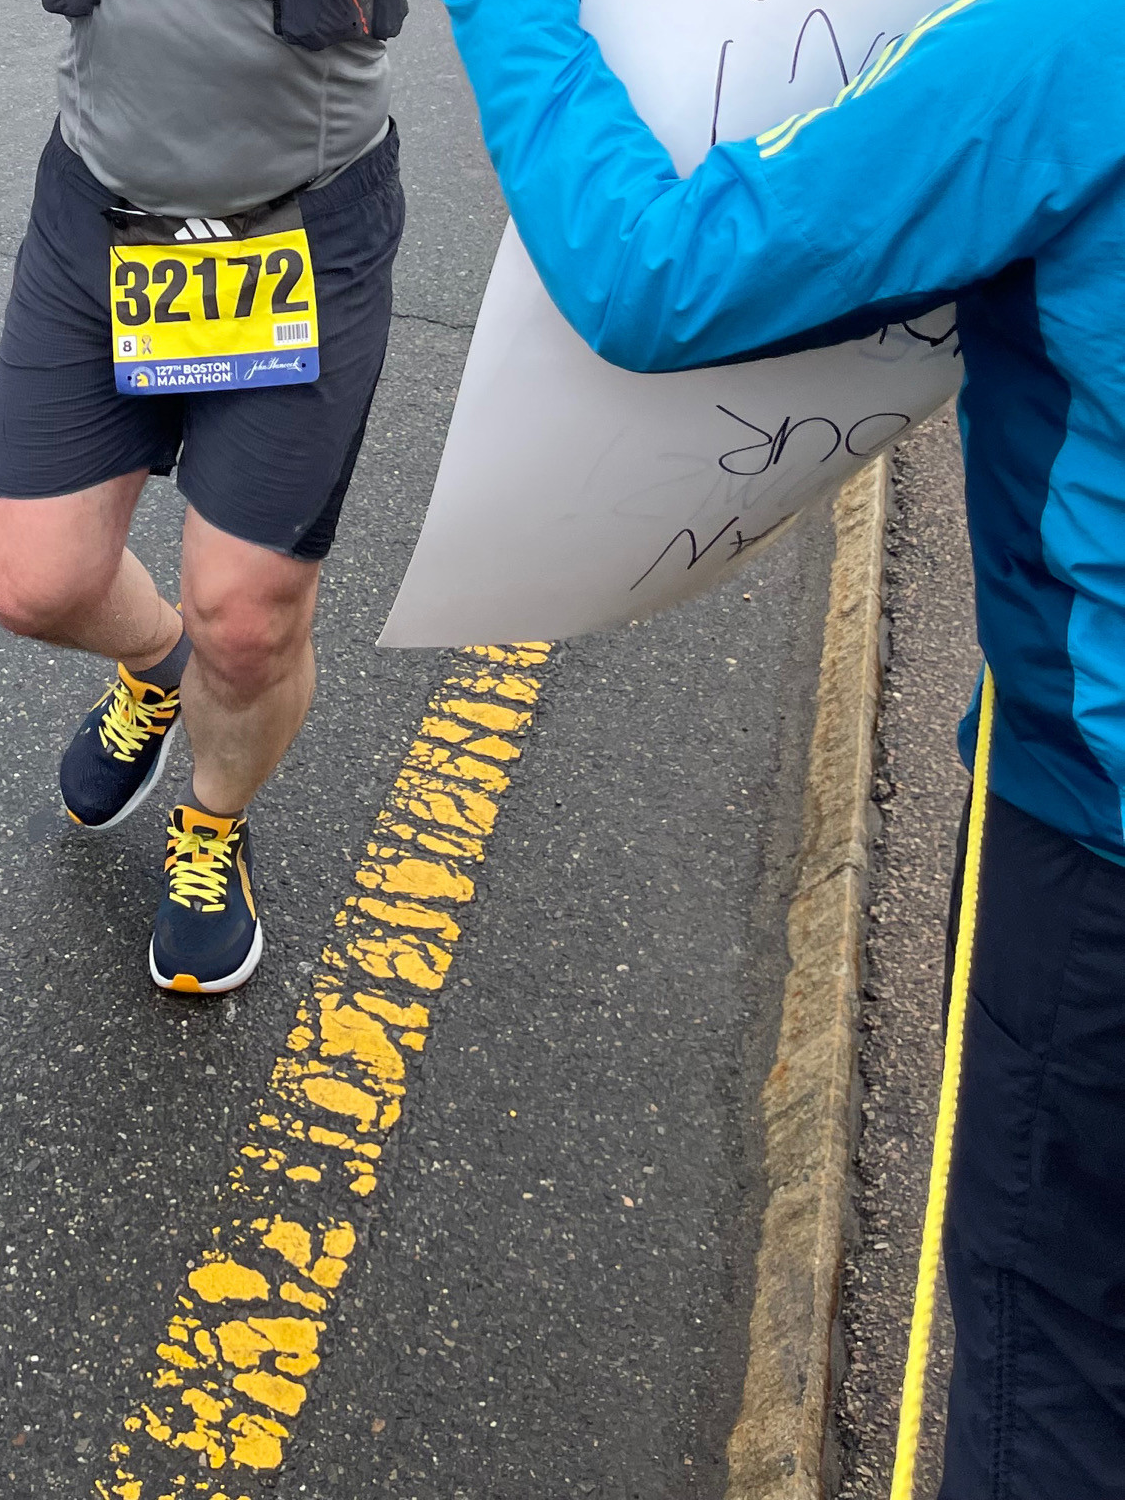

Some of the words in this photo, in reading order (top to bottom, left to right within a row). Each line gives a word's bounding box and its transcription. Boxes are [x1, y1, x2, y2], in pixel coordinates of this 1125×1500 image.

[115, 248, 309, 326] 32172
[122, 340, 133, 353] 8
[155, 364, 182, 377] 127TH
[183, 361, 231, 374] BOSTON
[156, 371, 232, 387] MARATHON
